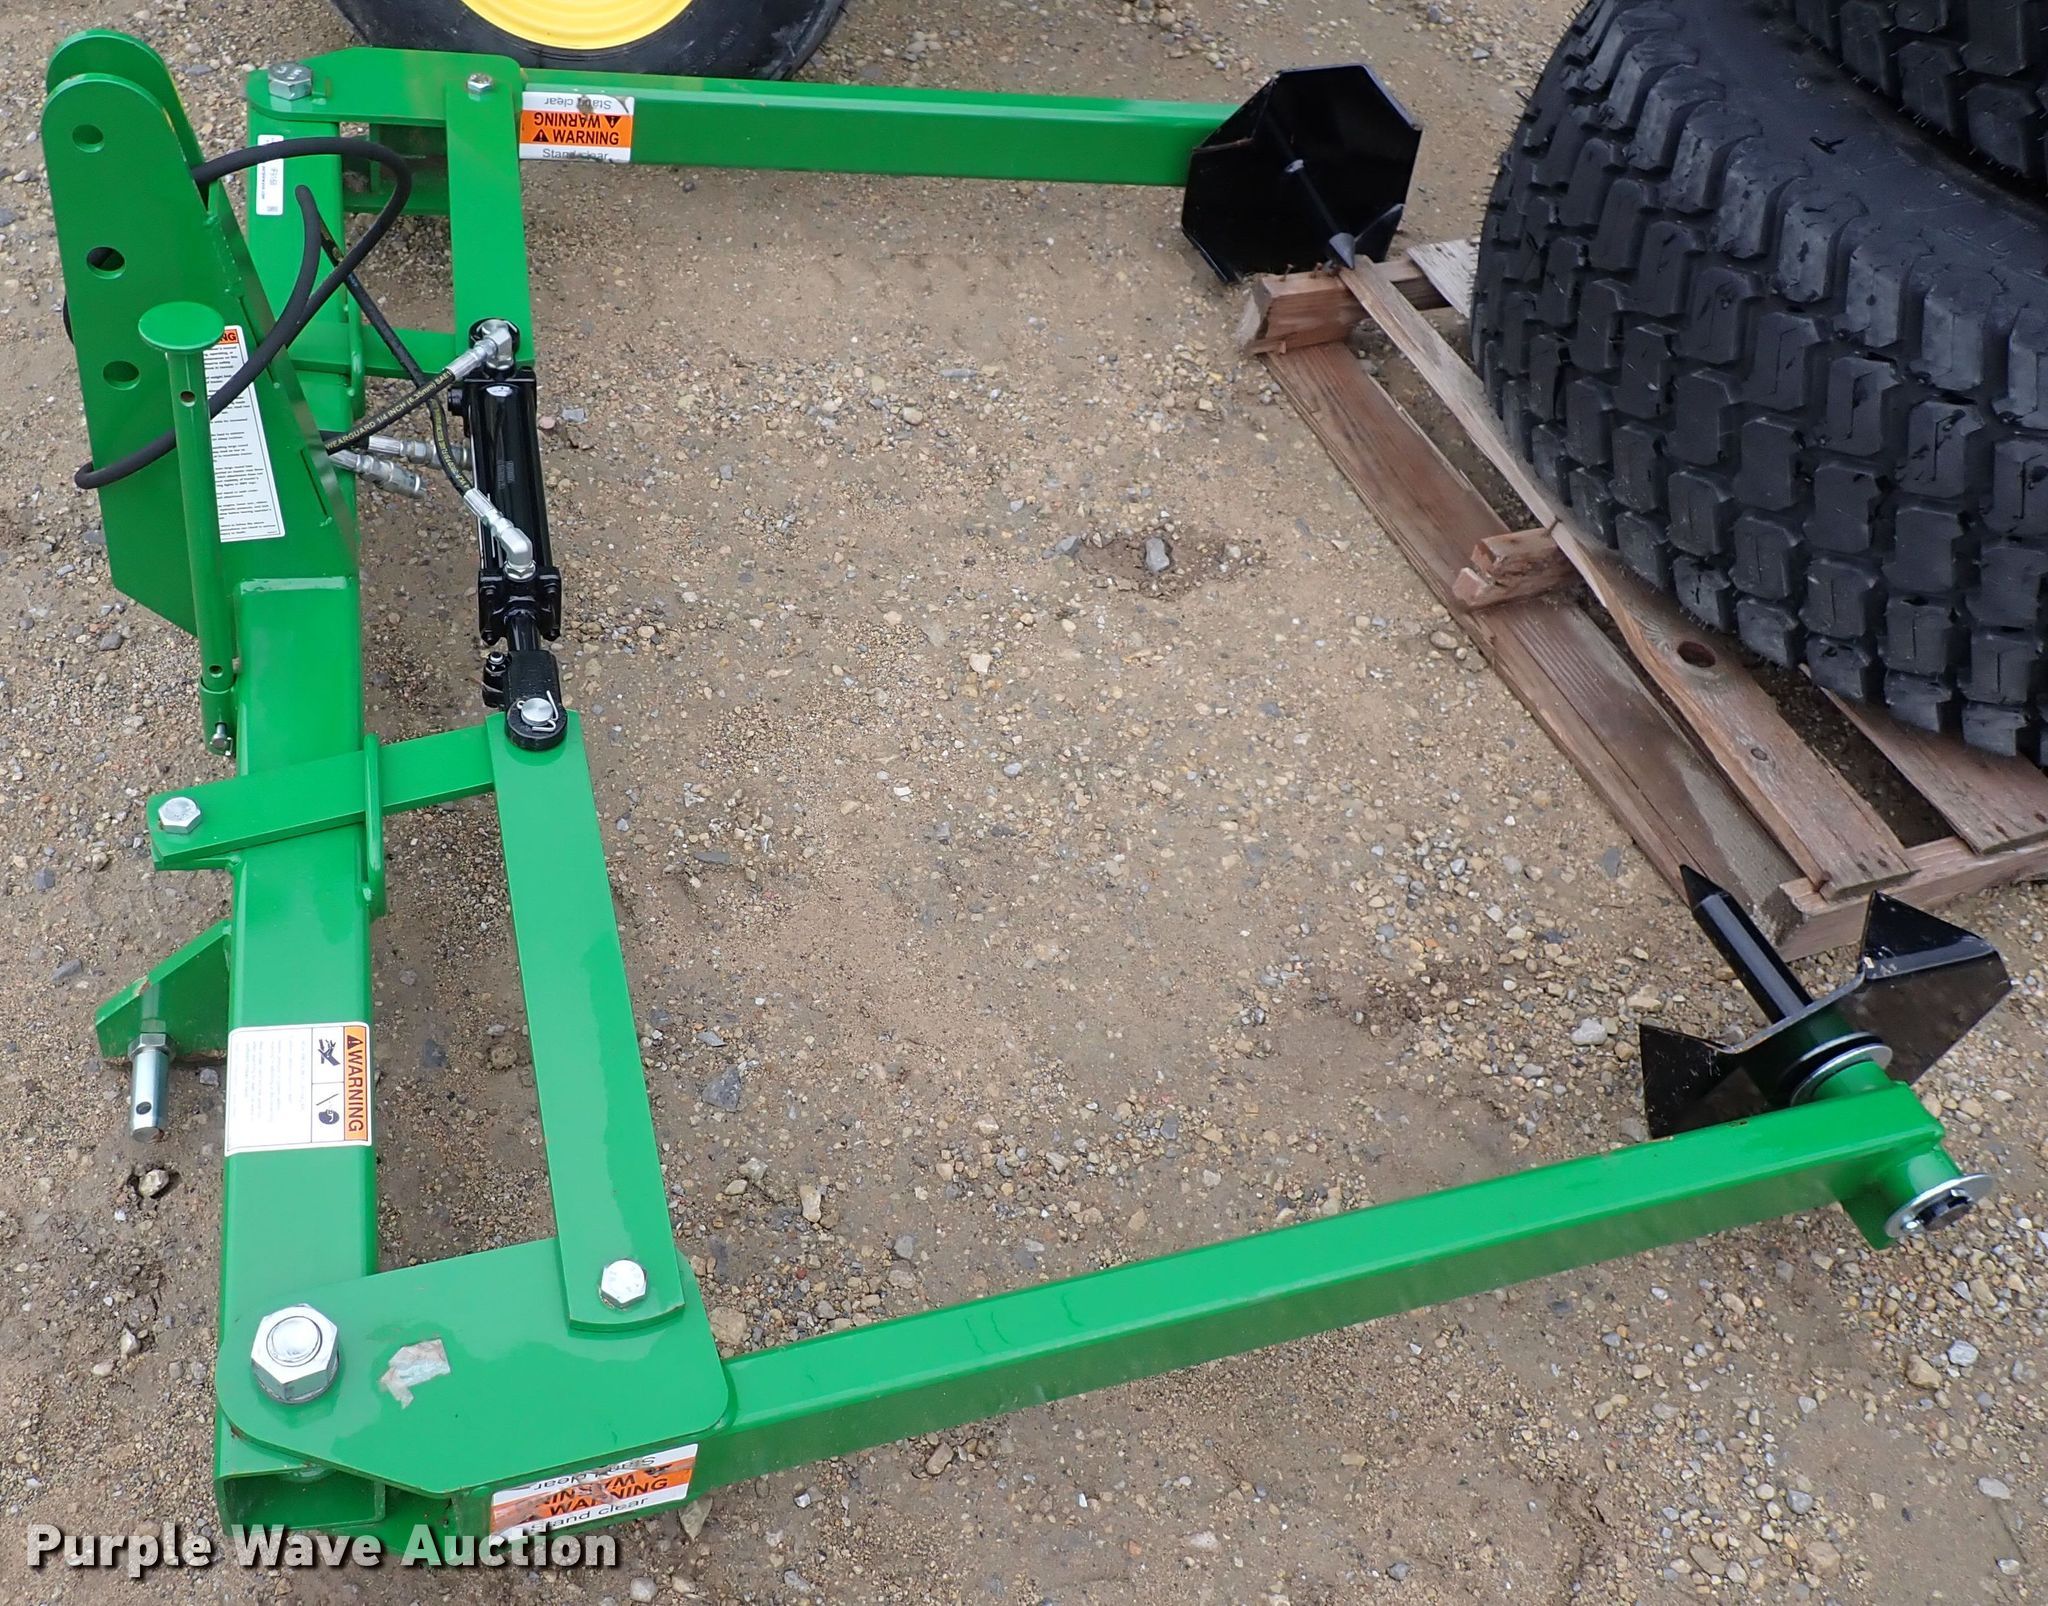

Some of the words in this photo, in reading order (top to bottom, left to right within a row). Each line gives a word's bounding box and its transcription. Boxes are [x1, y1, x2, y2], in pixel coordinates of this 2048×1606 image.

[534, 112, 601, 128] WARNING
[553, 129, 619, 145] WARNING
[324, 421, 376, 450] WEARGUARD
[387, 402, 406, 417] INCH
[348, 1050, 364, 1132] WARNING
[550, 1478, 668, 1517] WANING
[598, 1498, 648, 1515] clear
